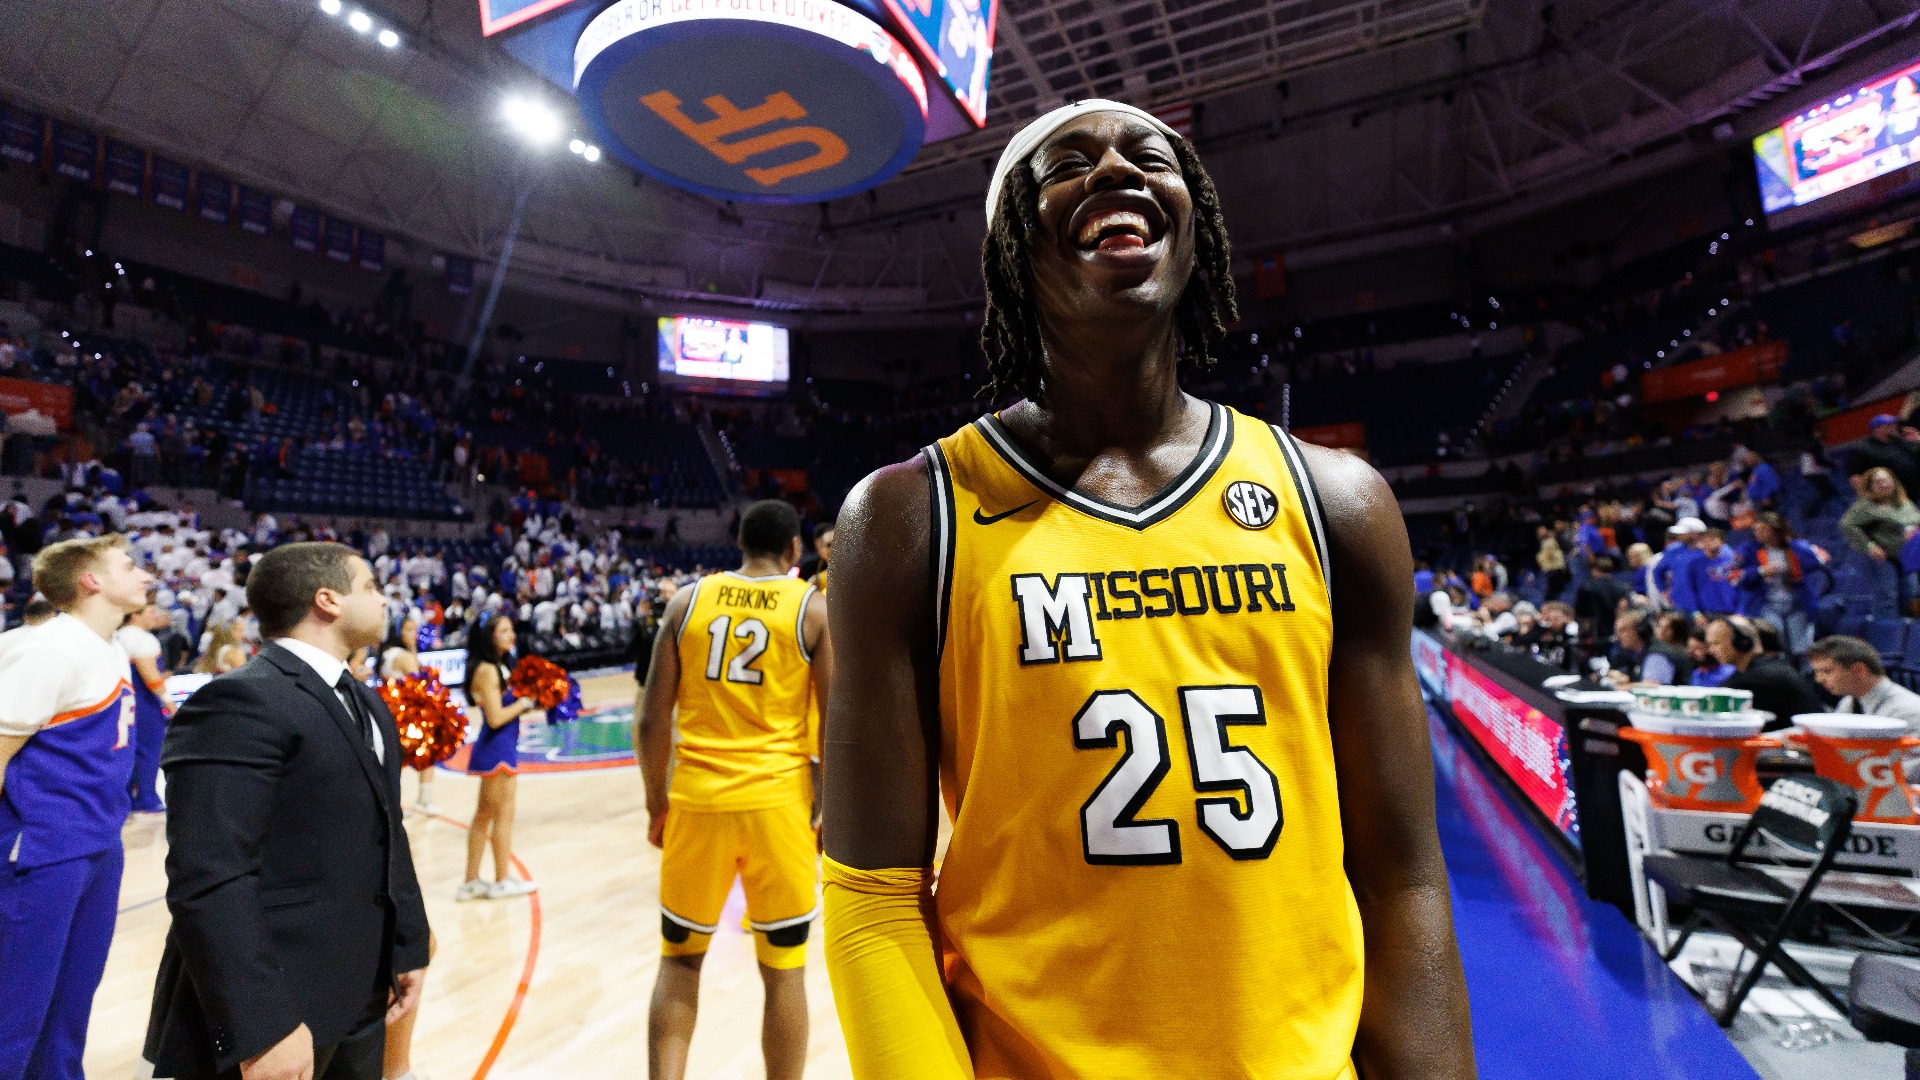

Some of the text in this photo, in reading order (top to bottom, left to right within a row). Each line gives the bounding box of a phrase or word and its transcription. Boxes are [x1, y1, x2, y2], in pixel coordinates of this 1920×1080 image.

[637, 89, 849, 186] UF
[1227, 482, 1276, 526] SEC
[716, 585, 780, 610] PERKINS
[1010, 563, 1296, 666] MISSOURI
[705, 614, 770, 685] 12
[1072, 684, 1284, 866] 25
[1680, 751, 1718, 785] G
[1857, 755, 1897, 787] G
